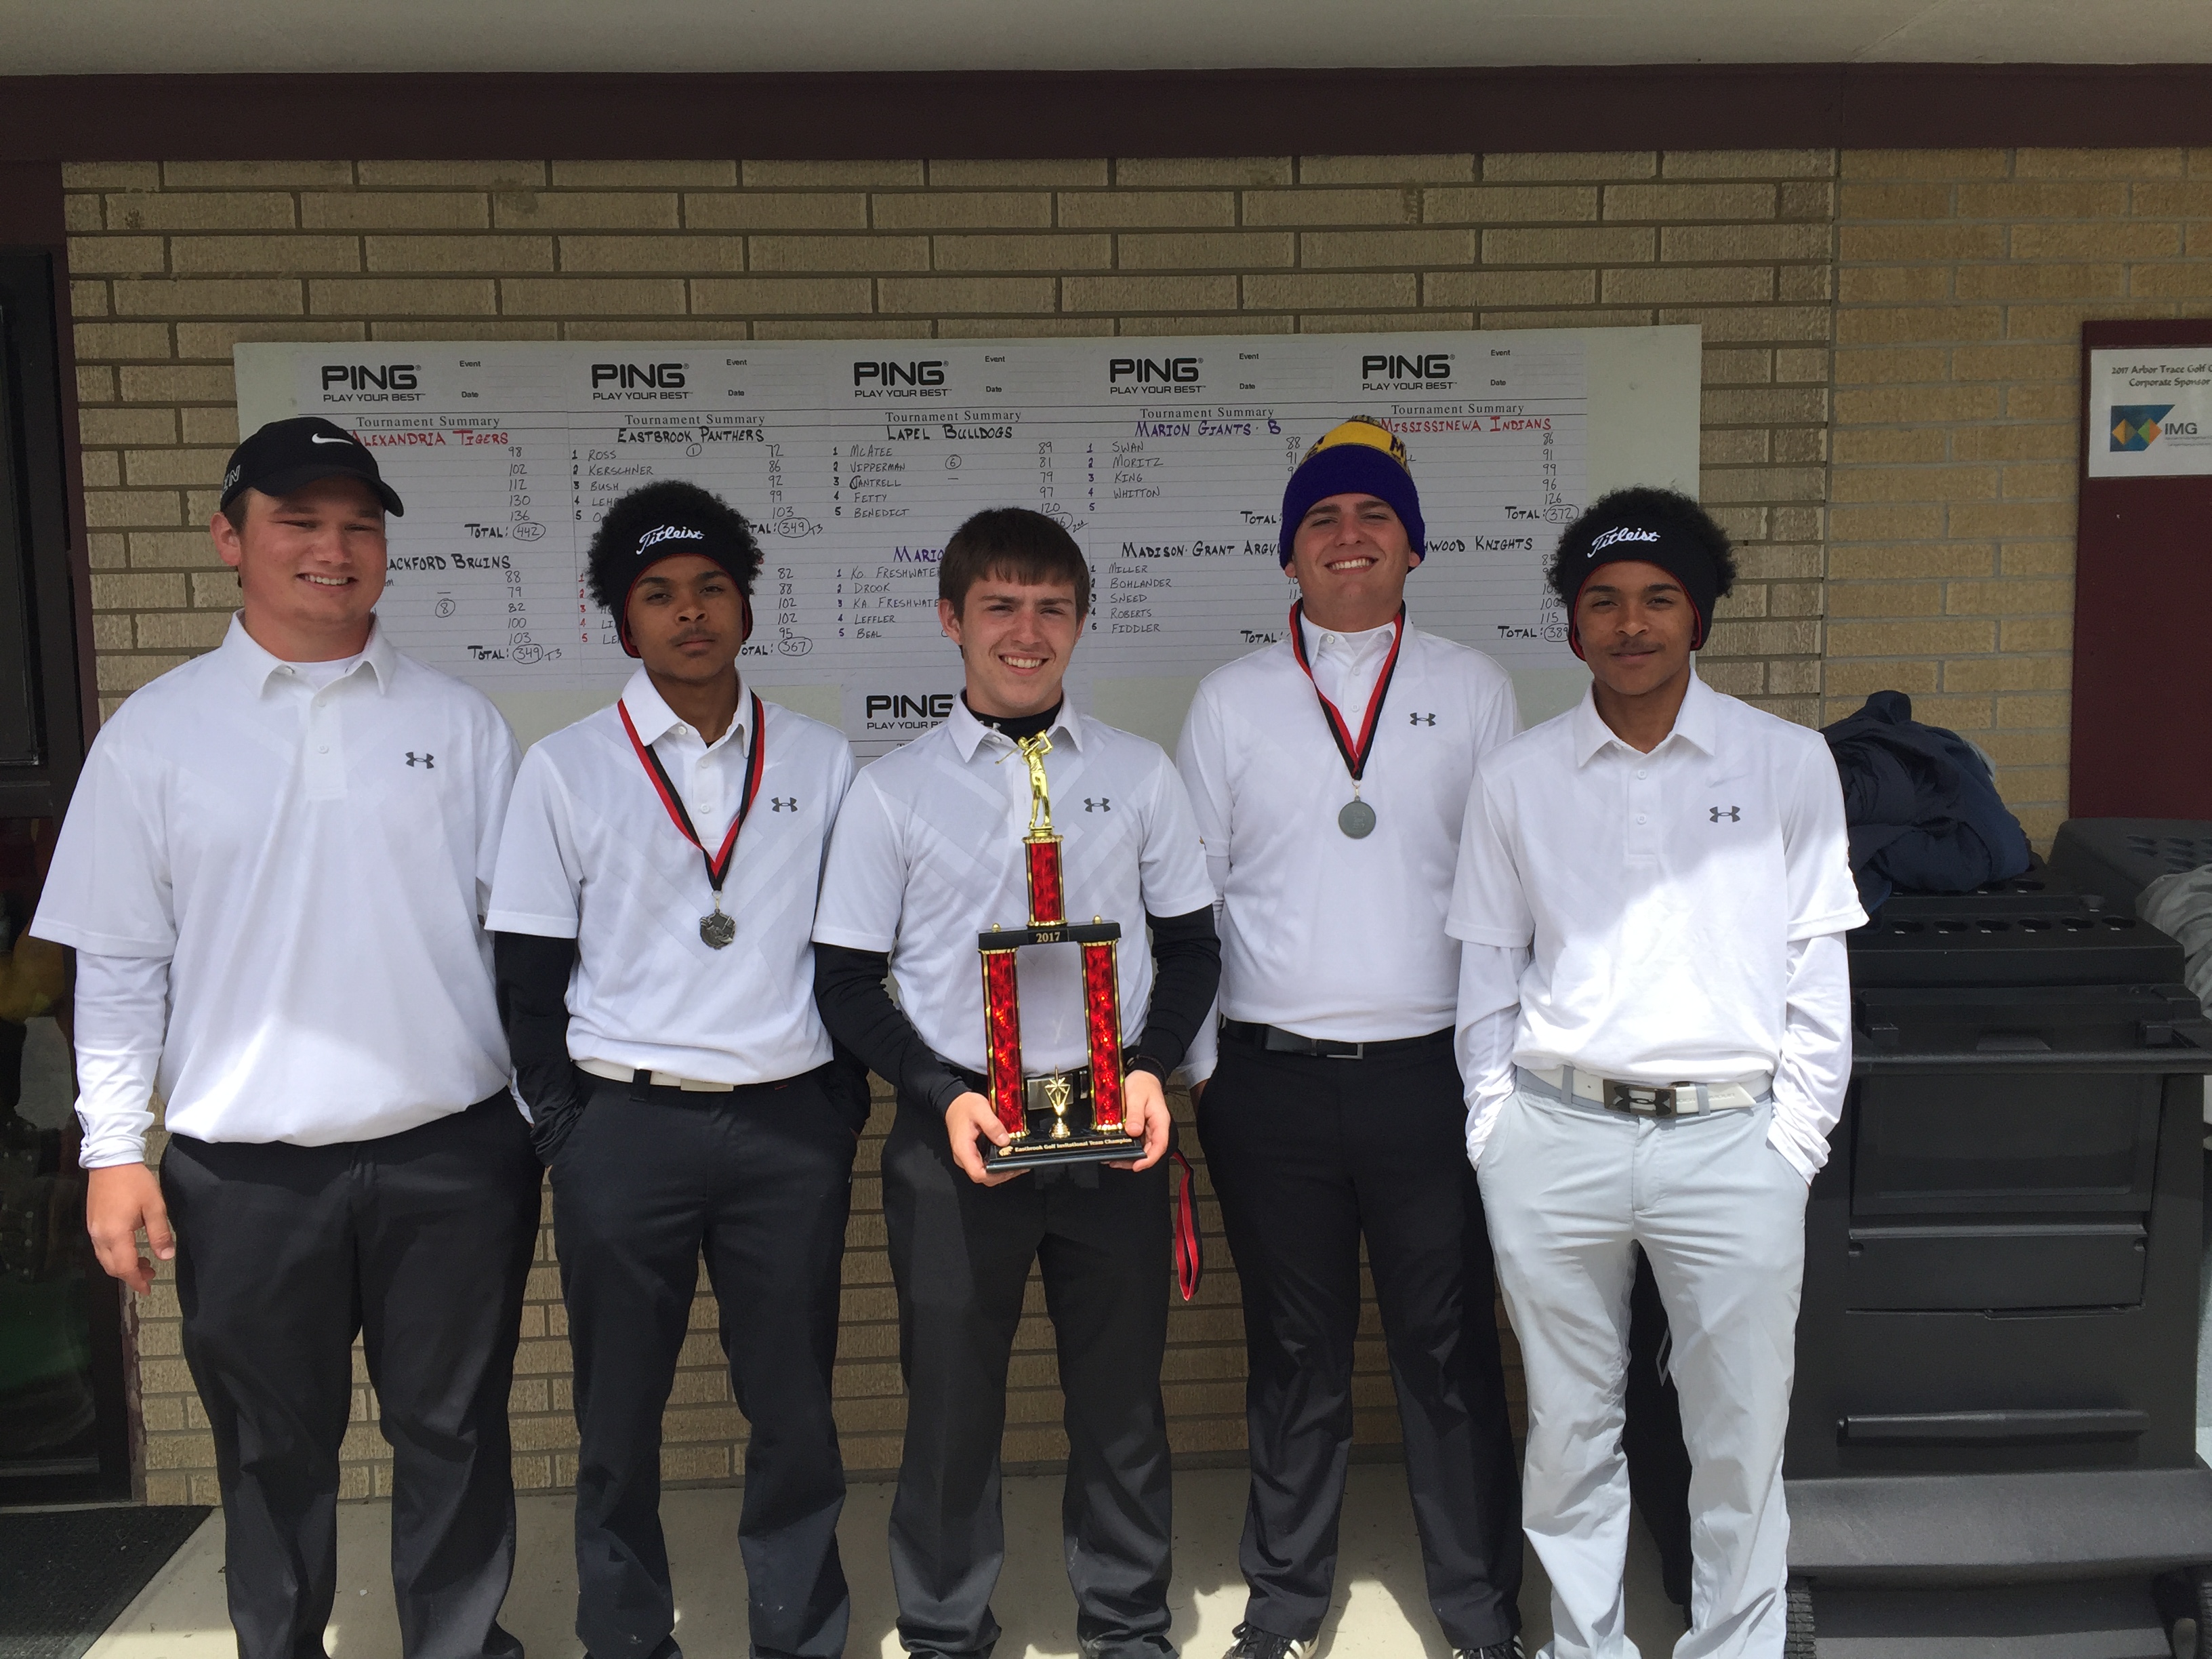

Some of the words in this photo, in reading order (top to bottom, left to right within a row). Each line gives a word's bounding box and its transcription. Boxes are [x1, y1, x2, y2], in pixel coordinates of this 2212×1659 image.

[1109, 358, 1199, 383] PING
[1362, 354, 1451, 380] PING
[2188, 364, 2207, 373] Golf
[321, 365, 417, 390] PING
[591, 363, 685, 388] PING
[853, 361, 945, 386] PING
[1362, 383, 1391, 391] PLAY
[1393, 382, 1422, 390] YOUR
[1426, 382, 1454, 390] BEST
[2129, 378, 2171, 388] Corporate
[2174, 377, 2210, 388] Sponsor
[323, 394, 353, 402] PLAY
[356, 394, 389, 402] YOUR
[392, 393, 421, 401] BEST
[593, 392, 622, 401] PLAY
[626, 392, 657, 400] YOUR
[855, 390, 882, 398] PLAY
[886, 389, 917, 397] YOUR
[920, 388, 949, 396] BEST
[1140, 408, 1212, 419] Tournament
[1218, 407, 1274, 419] Summary
[1391, 405, 1463, 415] Tournament
[1468, 404, 1524, 415] Summary
[356, 416, 433, 427] Tournament
[440, 415, 500, 428] Summary
[624, 414, 700, 426] Tournament
[706, 414, 765, 426] Summary
[885, 411, 959, 424] Tournament
[964, 411, 1021, 423] Summary
[1134, 421, 1190, 436] MARION
[1197, 420, 1251, 436] GIANTS
[1268, 419, 1281, 434] B
[1490, 416, 1552, 432] INDIANS
[2165, 422, 2197, 434] IMG
[453, 430, 508, 445] TIGERS
[617, 428, 693, 443] EASTBROOK
[700, 426, 764, 443] PANTHERS
[886, 425, 930, 441] LAPEL
[942, 424, 1012, 440] BULLDOGS
[1542, 432, 1554, 445] 86
[1038, 441, 1052, 453] 89
[1112, 441, 1144, 453] SWAN
[1286, 436, 1301, 449] 88
[508, 447, 522, 457] 98
[588, 449, 617, 462] ROSS
[765, 444, 783, 457] 72
[1542, 449, 1553, 461] 91
[850, 461, 905, 473] VIPPERMAN
[1040, 457, 1051, 468] 81
[1113, 457, 1164, 468] MORITZ
[1286, 451, 1298, 464] 91
[510, 464, 527, 476] 102
[588, 464, 654, 476] KERSCHNER
[769, 459, 781, 473] 86
[1542, 464, 1557, 476] 99
[590, 481, 619, 491] BUSH
[769, 475, 783, 487] 92
[1040, 472, 1053, 483] 79
[1114, 473, 1143, 483] KING
[510, 479, 527, 491] 112
[1542, 478, 1557, 491] 96
[769, 490, 782, 503] 99
[854, 492, 887, 503] FETTY
[1040, 487, 1053, 498] 97
[1113, 487, 1161, 499] WHITTON
[1544, 493, 1562, 505] 126
[510, 495, 531, 507] 130
[510, 510, 530, 521] 136
[772, 506, 794, 518] 103
[854, 508, 909, 518] BENEDICT
[1041, 503, 1060, 514] 120
[1550, 509, 1573, 520] 372
[516, 526, 540, 537] 442
[781, 522, 804, 533] 349
[636, 524, 705, 555] Titleist
[1475, 535, 1533, 550] KNIGHTS
[1587, 527, 1661, 558] Titleist
[893, 546, 944, 563] MARIO
[386, 556, 446, 571] ACKFORD
[451, 553, 511, 569] BRUINS
[1109, 562, 1149, 573] MILLER
[505, 571, 520, 583] 88
[777, 567, 794, 579] 82
[779, 583, 792, 595] 88
[855, 583, 890, 594] DROOK
[1110, 578, 1172, 589] BOHLANDER
[507, 587, 522, 598] 79
[1110, 594, 1147, 603] SNEED
[508, 602, 525, 613] 82
[778, 598, 797, 609] 102
[879, 596, 938, 608] FRESHWATE
[778, 613, 798, 625] 102
[854, 614, 895, 625] LEFFLER
[1111, 609, 1152, 619] ROBERTS
[1540, 612, 1559, 624] 115
[508, 618, 527, 630] 100
[1112, 623, 1161, 634] FIDDLER
[509, 633, 531, 645] 103
[779, 628, 793, 639] 95
[857, 628, 882, 639] BEAL
[514, 647, 541, 660] 349
[741, 642, 773, 655] OTAL:
[781, 641, 806, 653] 367
[866, 694, 954, 718] PING
[1036, 932, 1061, 943] 2017
